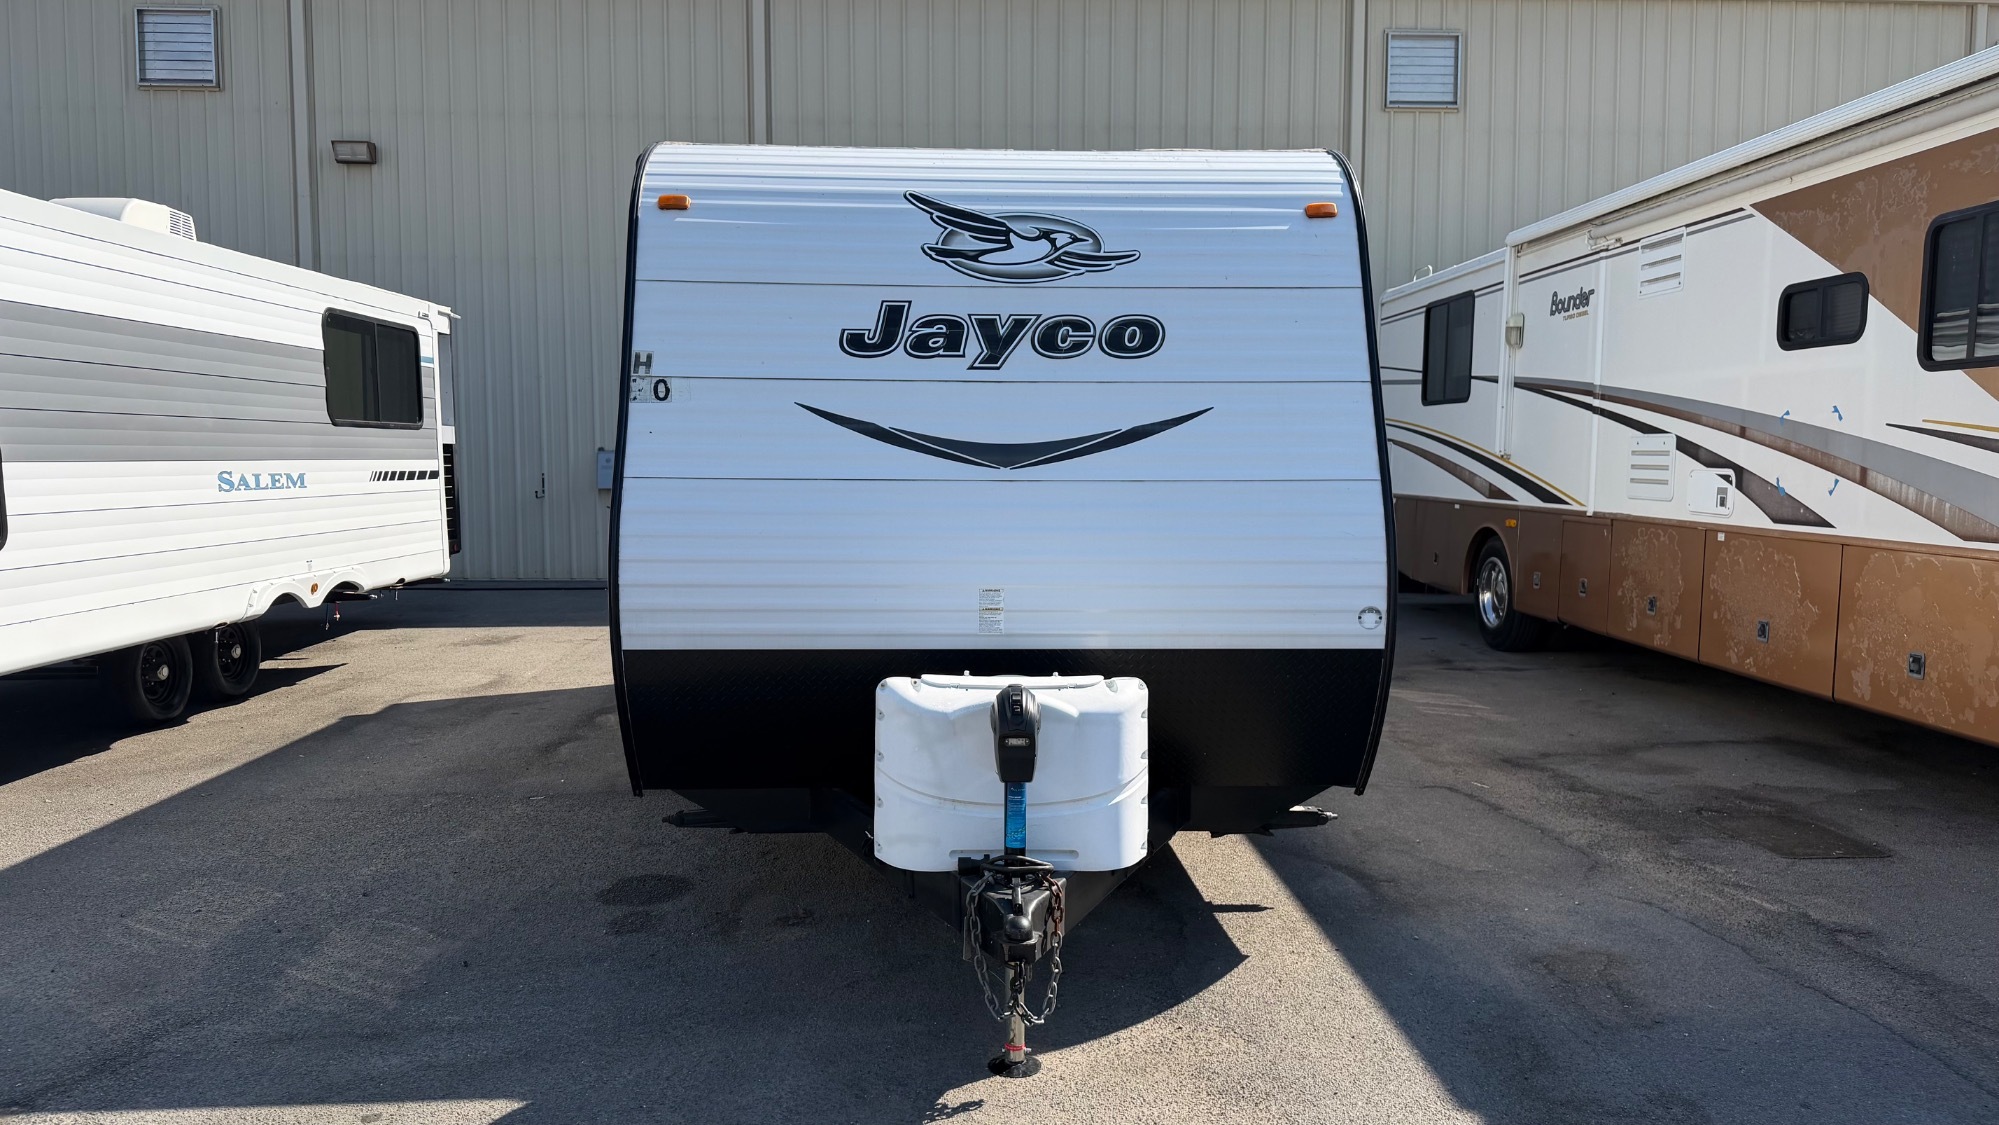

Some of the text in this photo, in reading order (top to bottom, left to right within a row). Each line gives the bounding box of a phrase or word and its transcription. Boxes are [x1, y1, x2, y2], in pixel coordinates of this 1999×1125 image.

[1550, 286, 1595, 316] Bounder
[839, 300, 1166, 370] Jayco
[633, 352, 652, 374] H
